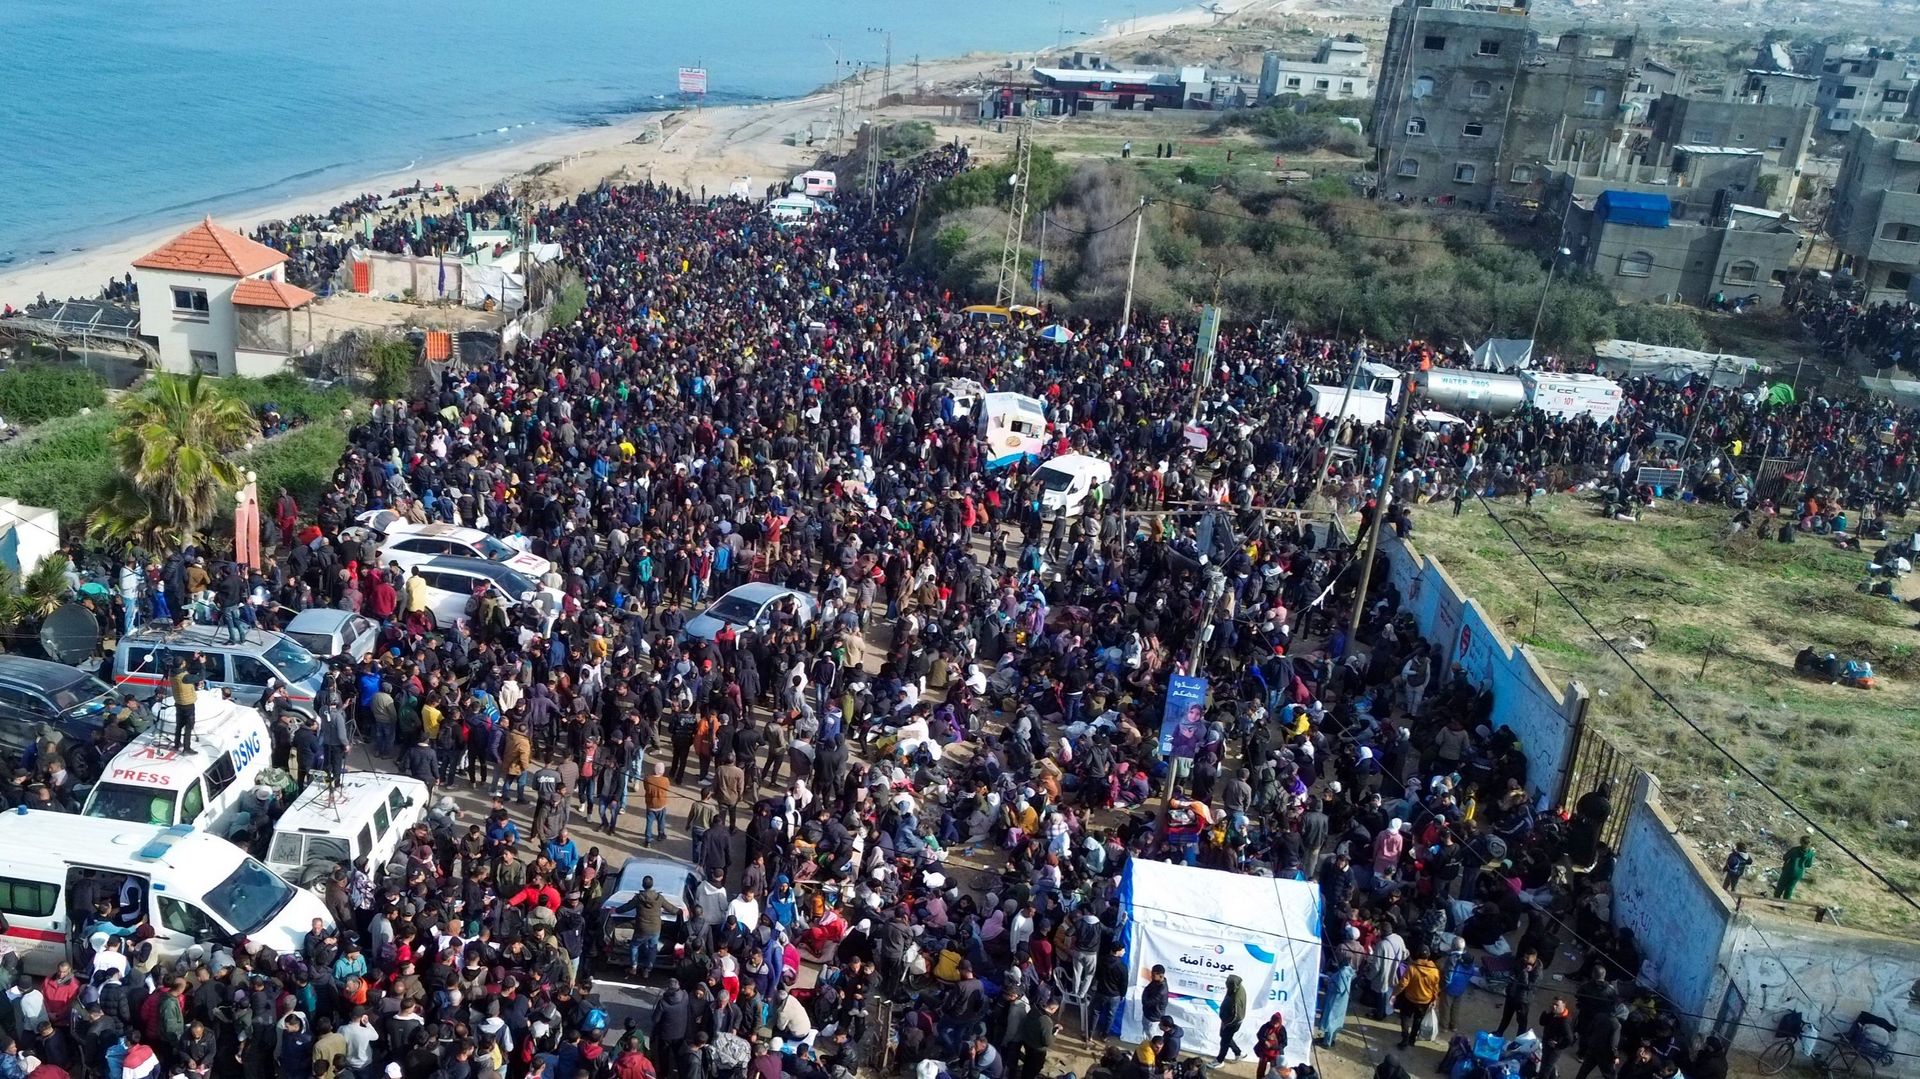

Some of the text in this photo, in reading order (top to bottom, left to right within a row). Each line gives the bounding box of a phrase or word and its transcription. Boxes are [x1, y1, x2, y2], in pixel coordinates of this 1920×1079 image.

[233, 731, 260, 772] DSNG
[112, 769, 171, 785] PRESS
[1179, 953, 1234, 972] عودة آمنة
